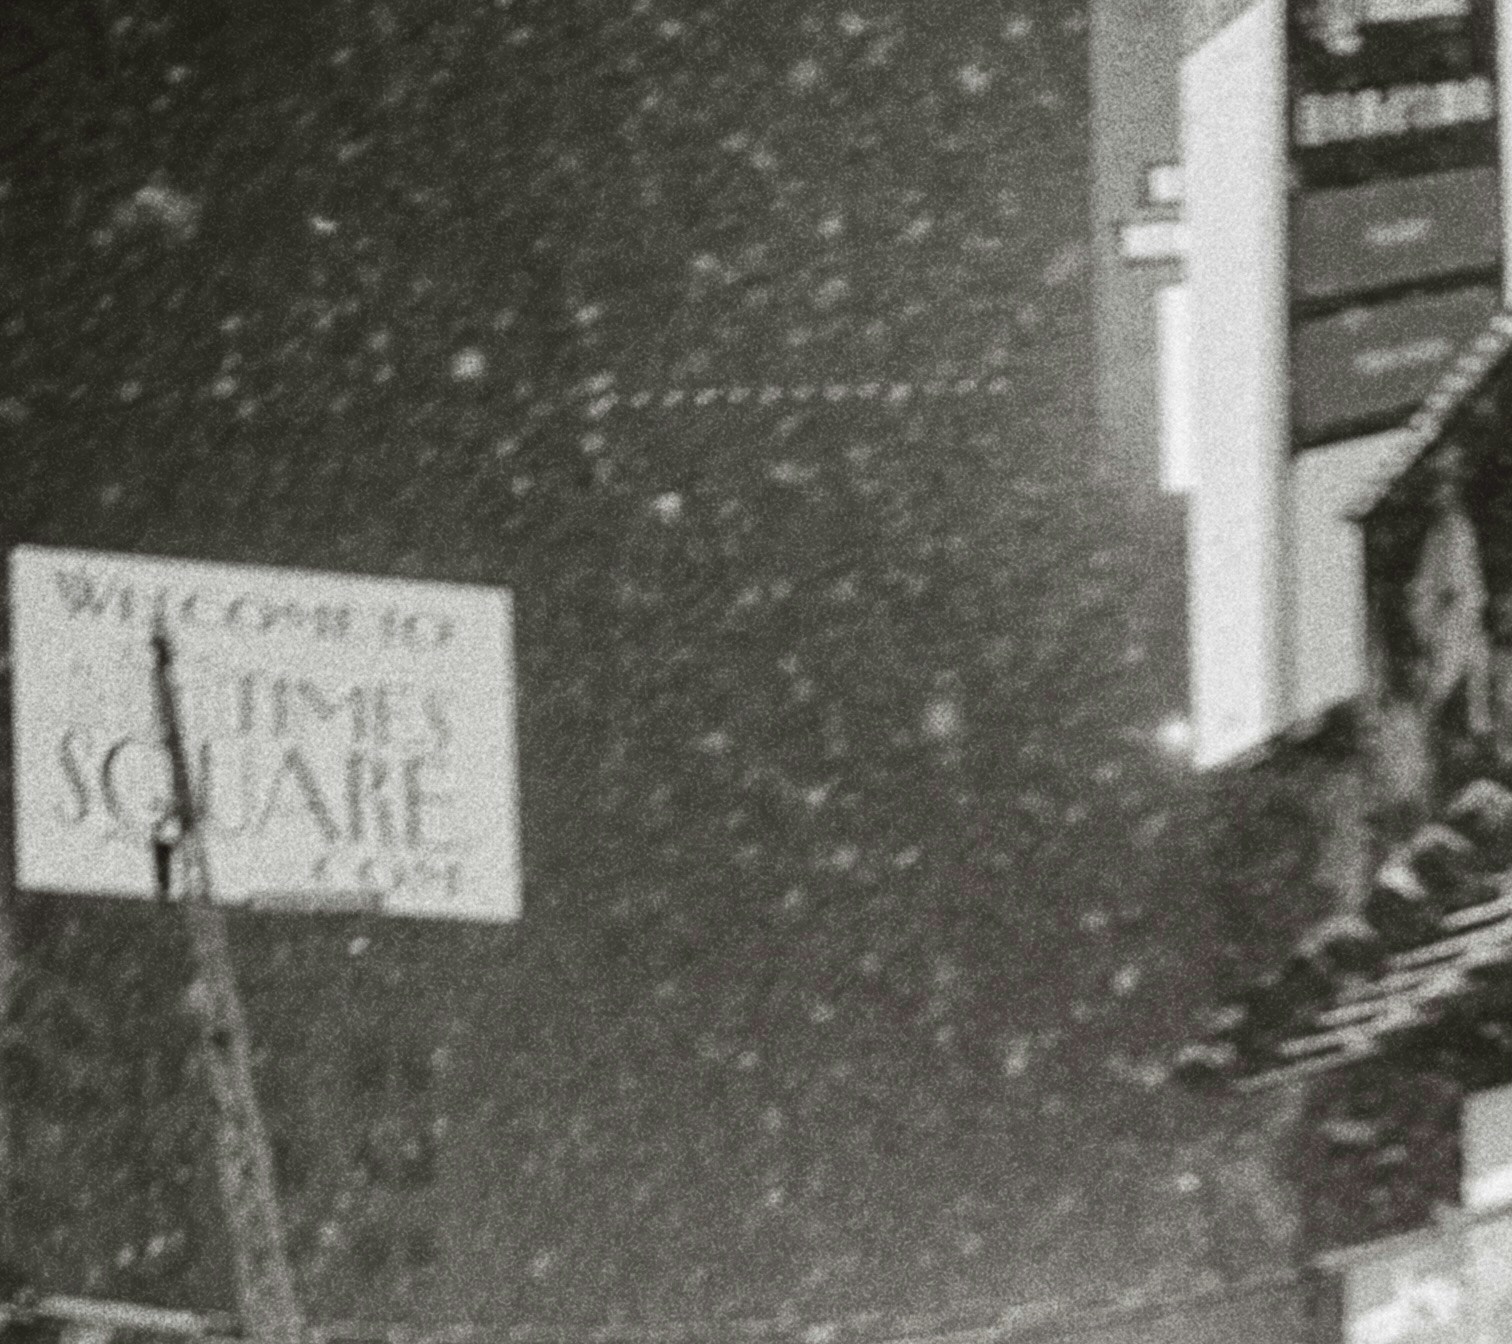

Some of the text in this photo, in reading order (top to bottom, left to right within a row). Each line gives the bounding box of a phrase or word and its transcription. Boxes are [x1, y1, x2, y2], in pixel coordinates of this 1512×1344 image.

[381, 606, 455, 649] TO
[218, 671, 456, 752] TIMES
[56, 729, 465, 852] SQUARE
